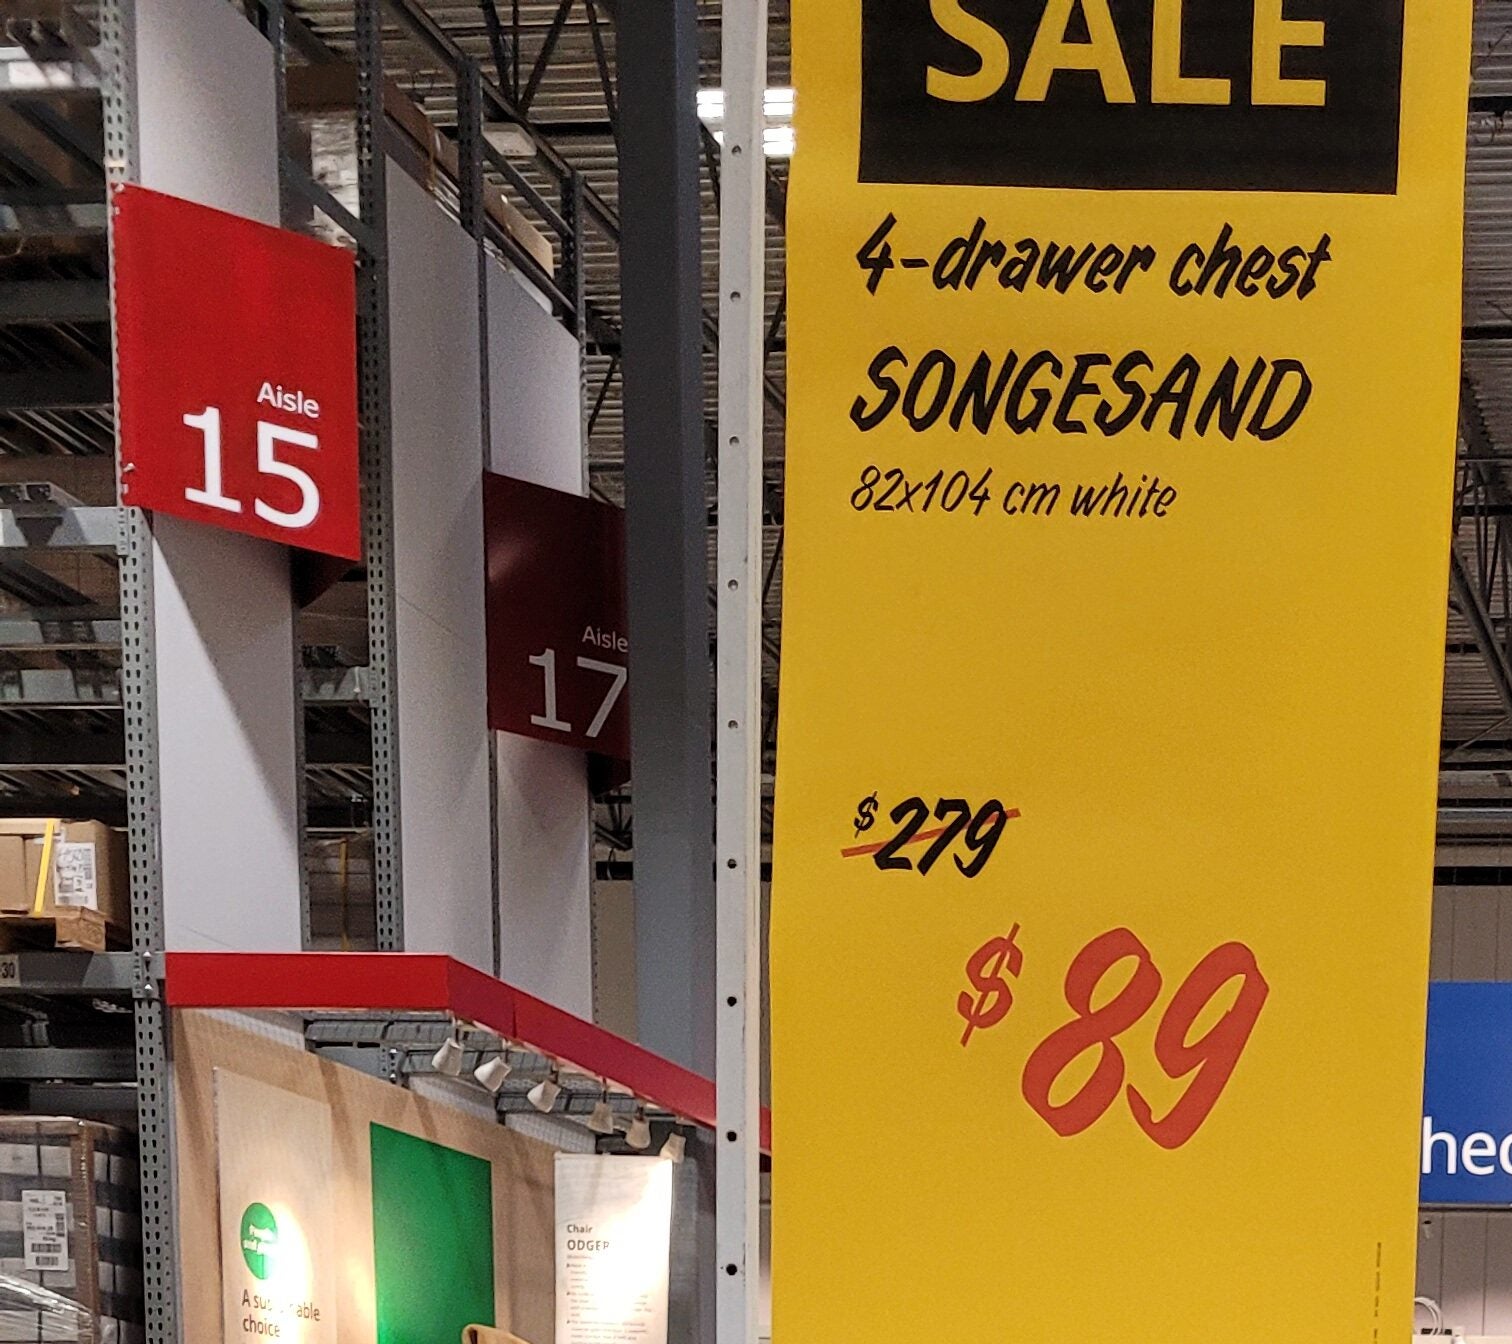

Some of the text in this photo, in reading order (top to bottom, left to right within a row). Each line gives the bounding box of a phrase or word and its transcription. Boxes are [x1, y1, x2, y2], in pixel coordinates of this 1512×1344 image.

[926, 0, 1327, 106] SALE
[855, 212, 1333, 301] 4-drawer chest
[256, 381, 320, 419] Aisle
[849, 345, 1313, 442] SONGESAND
[181, 405, 322, 531] 15
[850, 465, 1178, 519] 82x104 cm white
[581, 625, 628, 653] Aisle
[527, 647, 628, 739] 17
[851, 790, 1008, 879] $279
[956, 922, 1270, 1150] $89
[566, 1224, 593, 1234] Chair
[241, 1288, 251, 1308] A
[242, 1313, 281, 1338] choice
